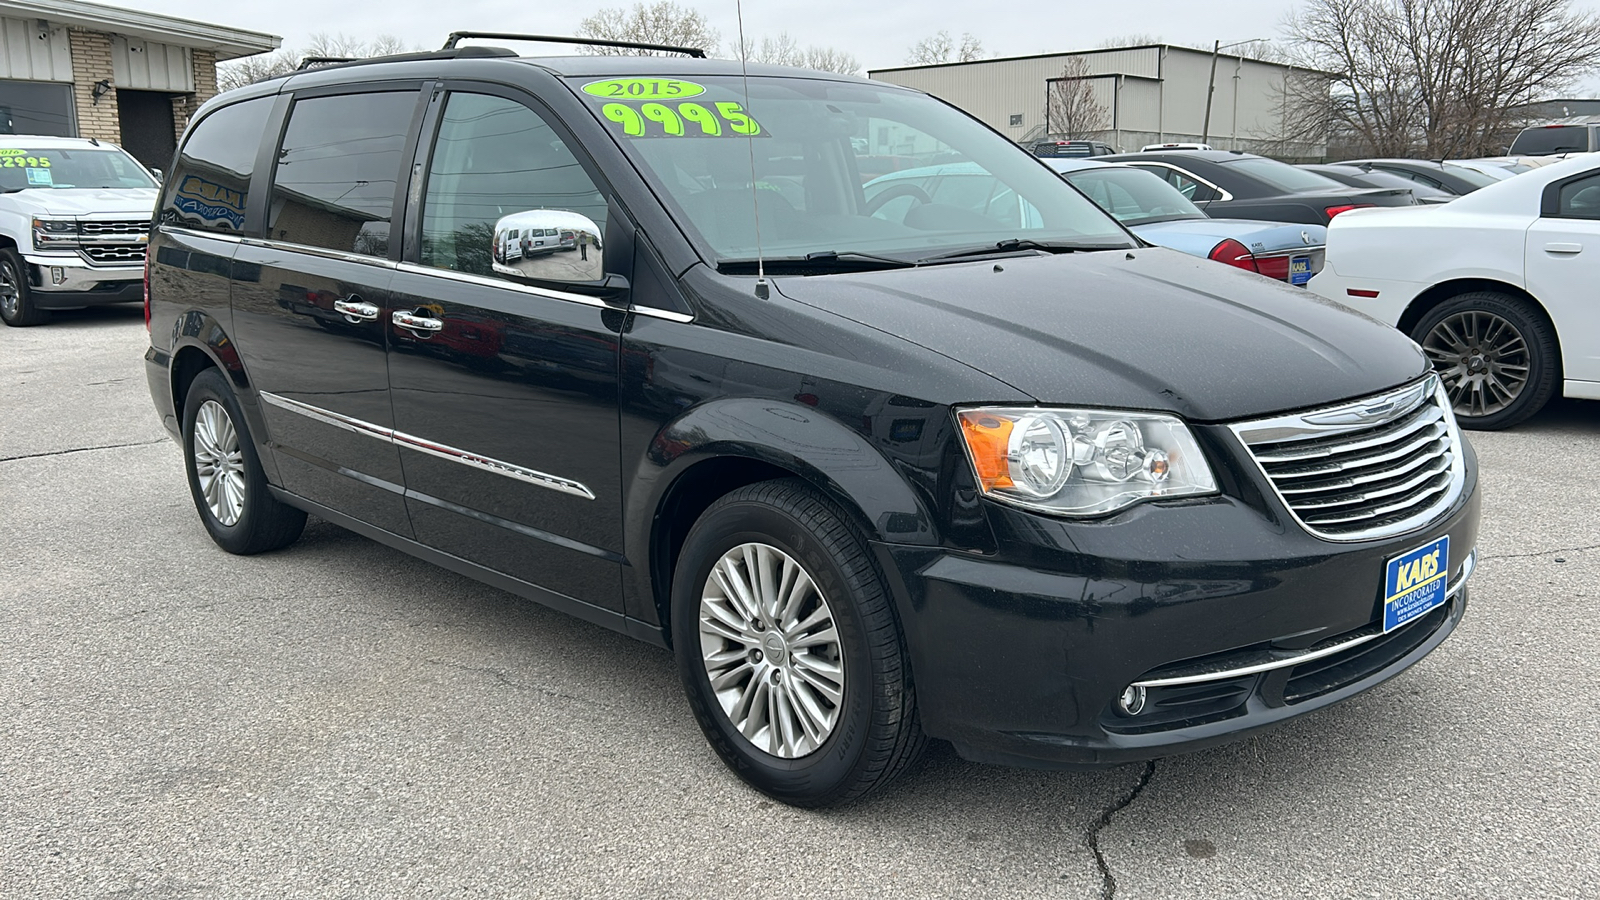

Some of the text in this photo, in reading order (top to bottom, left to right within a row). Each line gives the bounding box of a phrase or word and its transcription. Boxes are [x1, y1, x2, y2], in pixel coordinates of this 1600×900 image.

[607, 81, 682, 96] 2015
[602, 102, 761, 136] 9995
[0, 156, 52, 168] 2995
[1292, 262, 1307, 271] KARS
[460, 455, 568, 490] CHRYSLER
[1396, 549, 1440, 593] KARS
[1391, 580, 1441, 611] INCORPORATED
